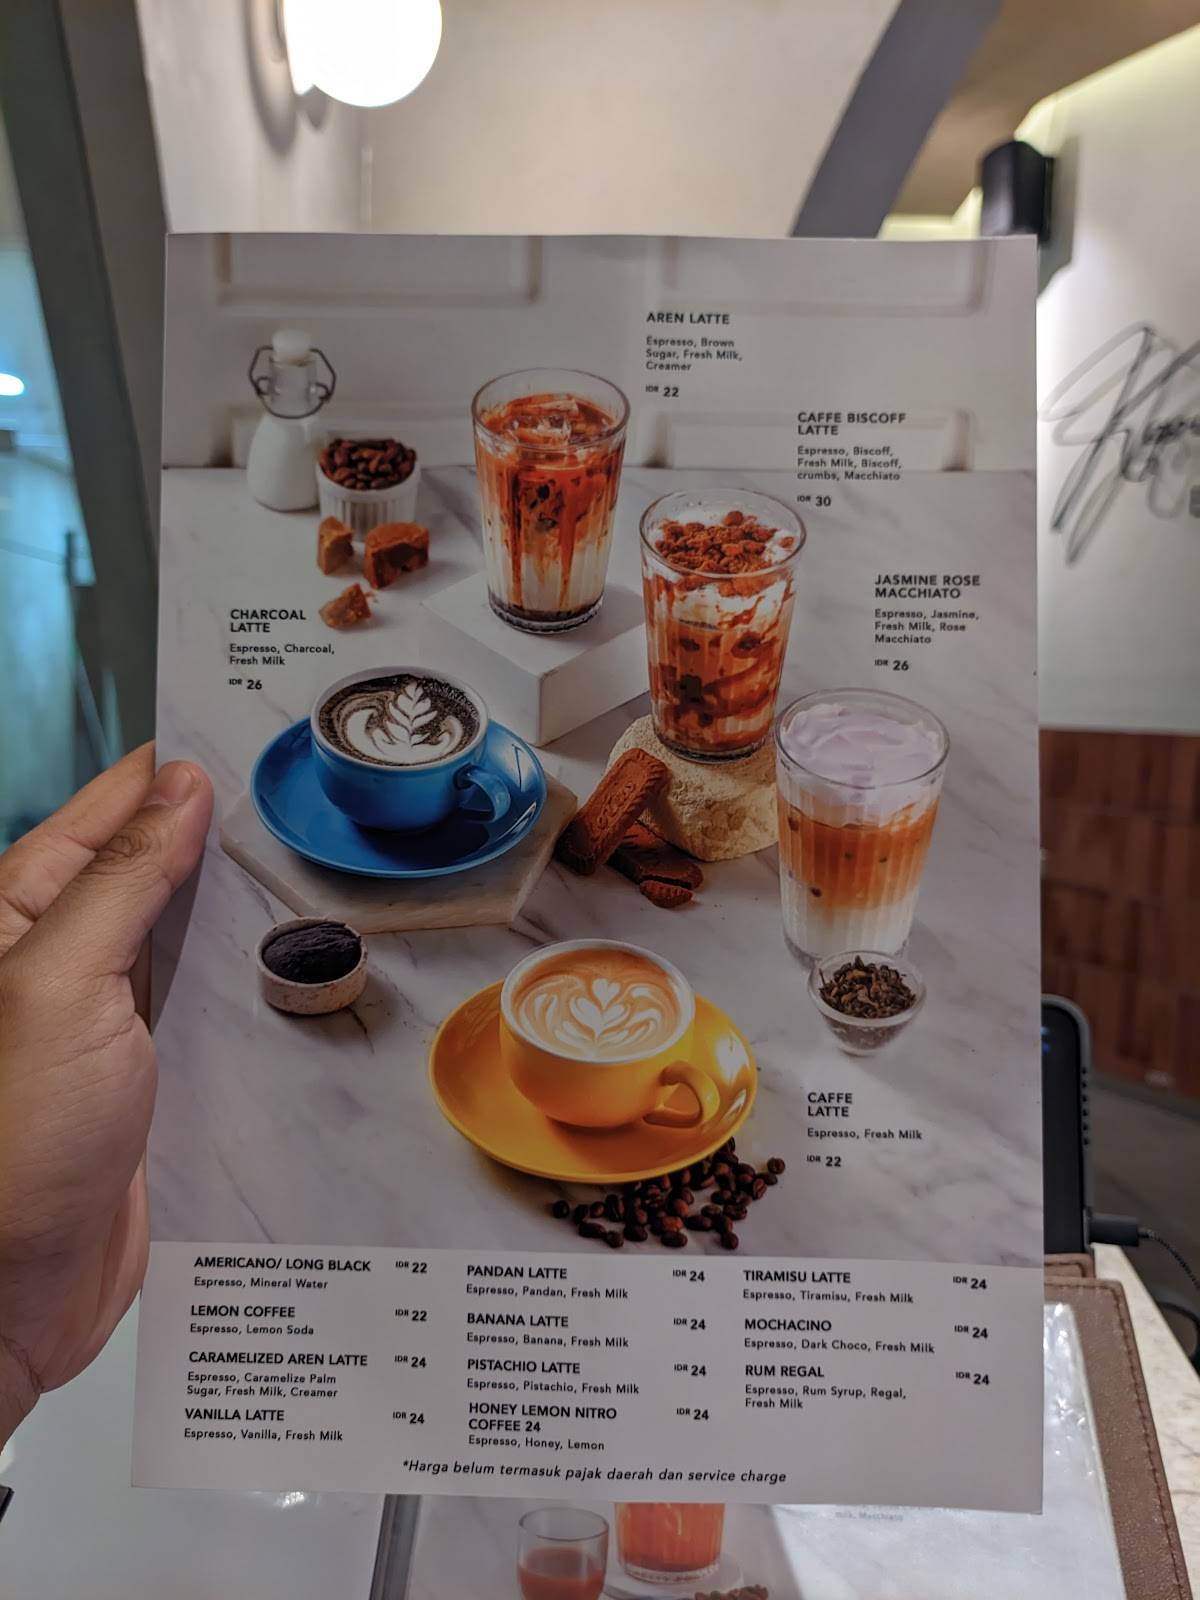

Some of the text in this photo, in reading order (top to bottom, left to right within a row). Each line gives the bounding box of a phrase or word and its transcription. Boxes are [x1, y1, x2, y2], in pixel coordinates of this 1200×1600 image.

[646, 312, 729, 324] AREN LATTE
[646, 336, 734, 349] Espresso, Brown
[646, 348, 742, 361] Sugar, Fresh Milk,
[646, 360, 691, 371] Creamer
[663, 387, 679, 397] 22
[798, 412, 906, 425] CAFFE BISCOFF
[798, 425, 838, 435] LATTE
[798, 445, 893, 457] Espresso, Biscoff,
[798, 458, 901, 469] Fresh Milk, Biscoff,
[797, 470, 900, 481] crumbs, Macchiato
[816, 496, 831, 507] 30
[875, 574, 980, 586] JASMINE ROSE
[875, 587, 961, 599] MACCHIATO
[230, 609, 306, 620] CHARCOAL
[875, 608, 979, 620] Espresso, Jasmine,
[230, 622, 270, 632] LATTE
[875, 621, 966, 632] Fresh Milk, Rose
[875, 634, 931, 643] Macchiato
[230, 643, 334, 654] Espresso, Charcoal,
[230, 655, 285, 665] Fresh Milk
[893, 660, 909, 671] 26
[247, 680, 262, 690] 26
[808, 1092, 852, 1104] CAFFE
[808, 1106, 848, 1117] LATTE
[808, 1128, 922, 1139] Espresso, Fresh Milk
[826, 1156, 841, 1167] 22
[194, 1257, 370, 1271] AMERICANO/ LONG BLACK
[412, 1262, 427, 1273] 22
[467, 1265, 567, 1279] PANDAN LATTE
[689, 1271, 705, 1282] 24
[743, 1270, 850, 1283] TIRAMISU LATTE
[194, 1276, 328, 1288] Espresso, Mineral Water
[953, 1276, 987, 1289] IDR 24
[467, 1284, 627, 1298] Espresso, Pandan, Fresh Milk
[743, 1289, 913, 1303] Espresso, Tiramisu, Fresh Milk
[191, 1305, 295, 1318] LEMON COFFEE
[412, 1310, 427, 1321] 22
[467, 1313, 568, 1327] BANANA LATTE
[690, 1319, 706, 1330] 24
[745, 1319, 832, 1331] MOCHACINO
[190, 1323, 314, 1335] Espresso, Lemon Soda
[954, 1325, 988, 1338] IDR 24
[467, 1332, 628, 1347] Espresso, Banana, Fresh Milk
[745, 1338, 934, 1353] Espresso, Dark Choco, Fresh Milk
[189, 1352, 367, 1366] CARAMELIZED AREN LATTE
[411, 1357, 426, 1368] 24
[468, 1359, 580, 1374] PISTACHIO LATTE
[691, 1365, 706, 1376] 24
[746, 1365, 824, 1377] RUM REGAL
[188, 1371, 336, 1383] Espresso, Caramelize Palm
[974, 1374, 989, 1385] 24
[187, 1385, 338, 1397] Sugar, Fresh Milk, Creamer
[467, 1378, 639, 1394] Espresso, Pistachio, Fresh Milk
[746, 1384, 906, 1400] Espresso, Rum Syrup, Regal,
[746, 1398, 803, 1408] Fresh Milk
[185, 1408, 284, 1421] VANILLA LATTE
[469, 1403, 617, 1419] HONEY LEMON NITRO
[694, 1409, 709, 1420] 24
[410, 1413, 424, 1424] 24
[469, 1418, 541, 1432] COFFEE 24
[184, 1428, 342, 1441] Espresso, Vanilla, Fresh Milk
[469, 1435, 604, 1450] Espresso, Honey, Lemon
[454, 1461, 494, 1474] belum
[500, 1465, 560, 1477] termasuk
[565, 1467, 601, 1481] pajak
[607, 1468, 653, 1480] daerah
[659, 1469, 682, 1480] dan
[688, 1470, 735, 1481] service
[741, 1470, 786, 1485] charge
